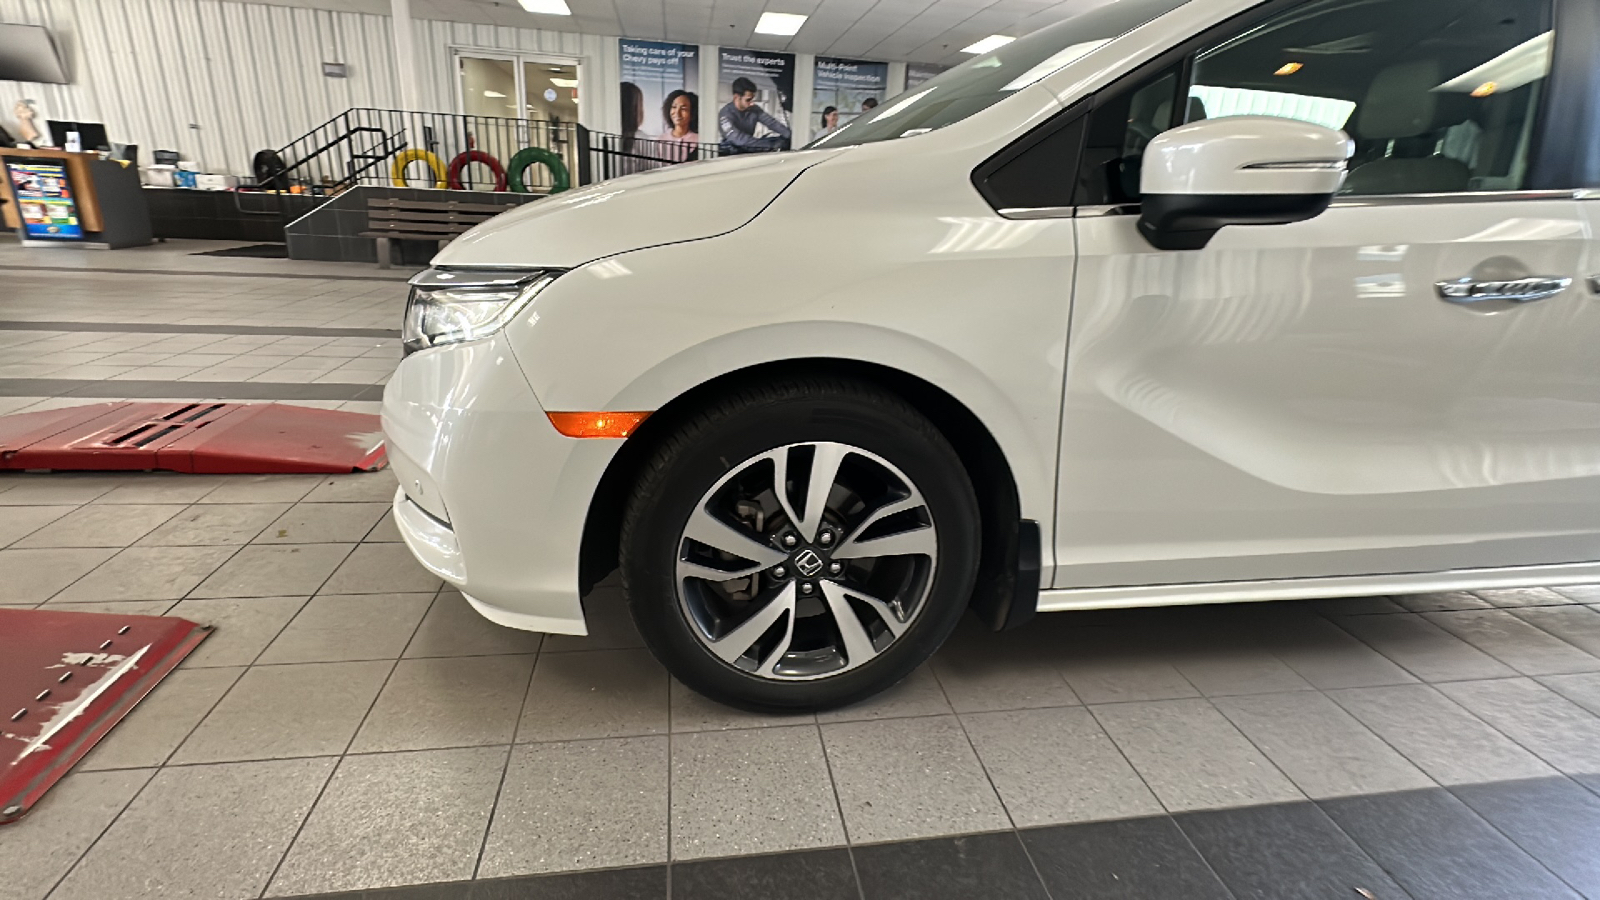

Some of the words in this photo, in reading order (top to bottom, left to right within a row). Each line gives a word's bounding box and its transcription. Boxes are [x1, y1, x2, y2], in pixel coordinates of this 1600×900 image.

[622, 45, 647, 55] Taking
[667, 48, 676, 56] of
[622, 54, 647, 64] Chevy
[648, 57, 666, 65] pays
[667, 57, 679, 65] off
[722, 53, 742, 62] Trust
[743, 55, 756, 63] the
[757, 57, 785, 66] experts
[817, 69, 842, 80] Vehicle
